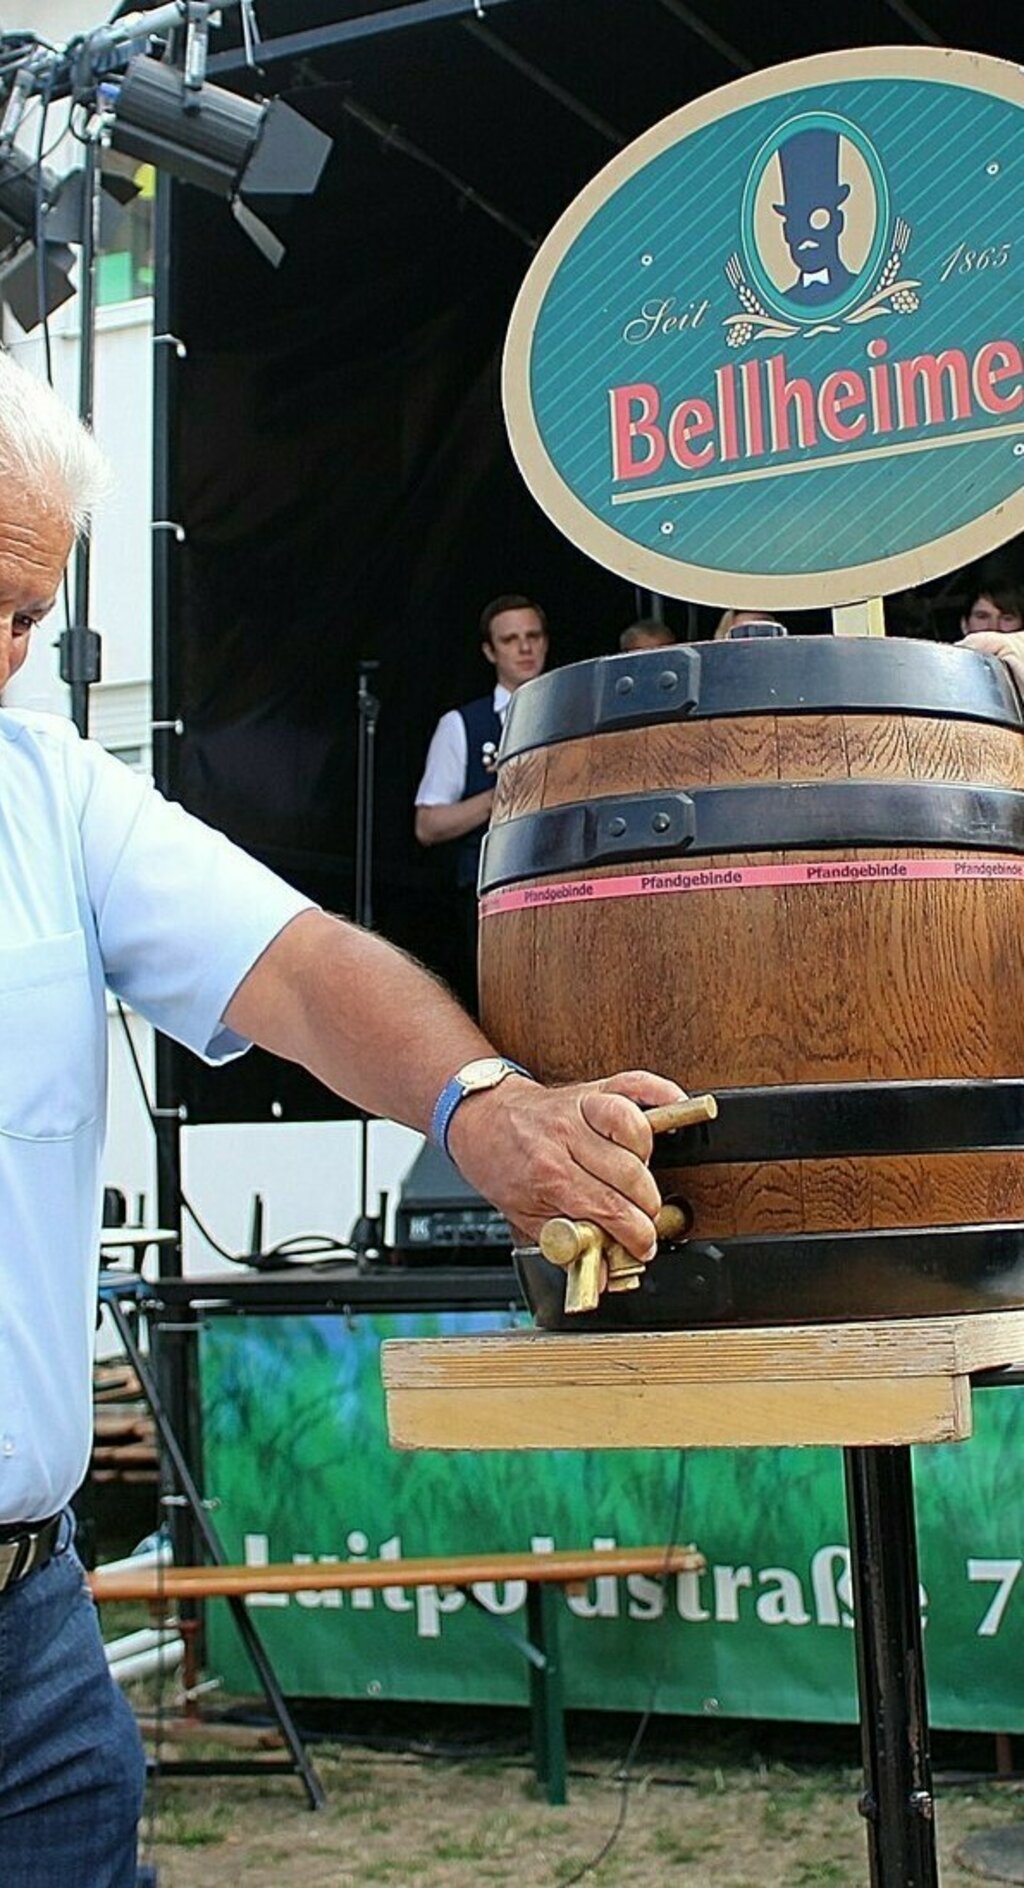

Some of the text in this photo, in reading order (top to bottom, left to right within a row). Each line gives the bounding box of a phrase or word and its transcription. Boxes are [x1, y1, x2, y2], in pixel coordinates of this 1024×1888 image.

[622, 242, 1012, 345] Seit 1865
[523, 861, 1024, 903] Pfandgebinde Pfandgebinde Pfandgebinde Pfandgebinde
[966, 1556, 1024, 1637] 7
